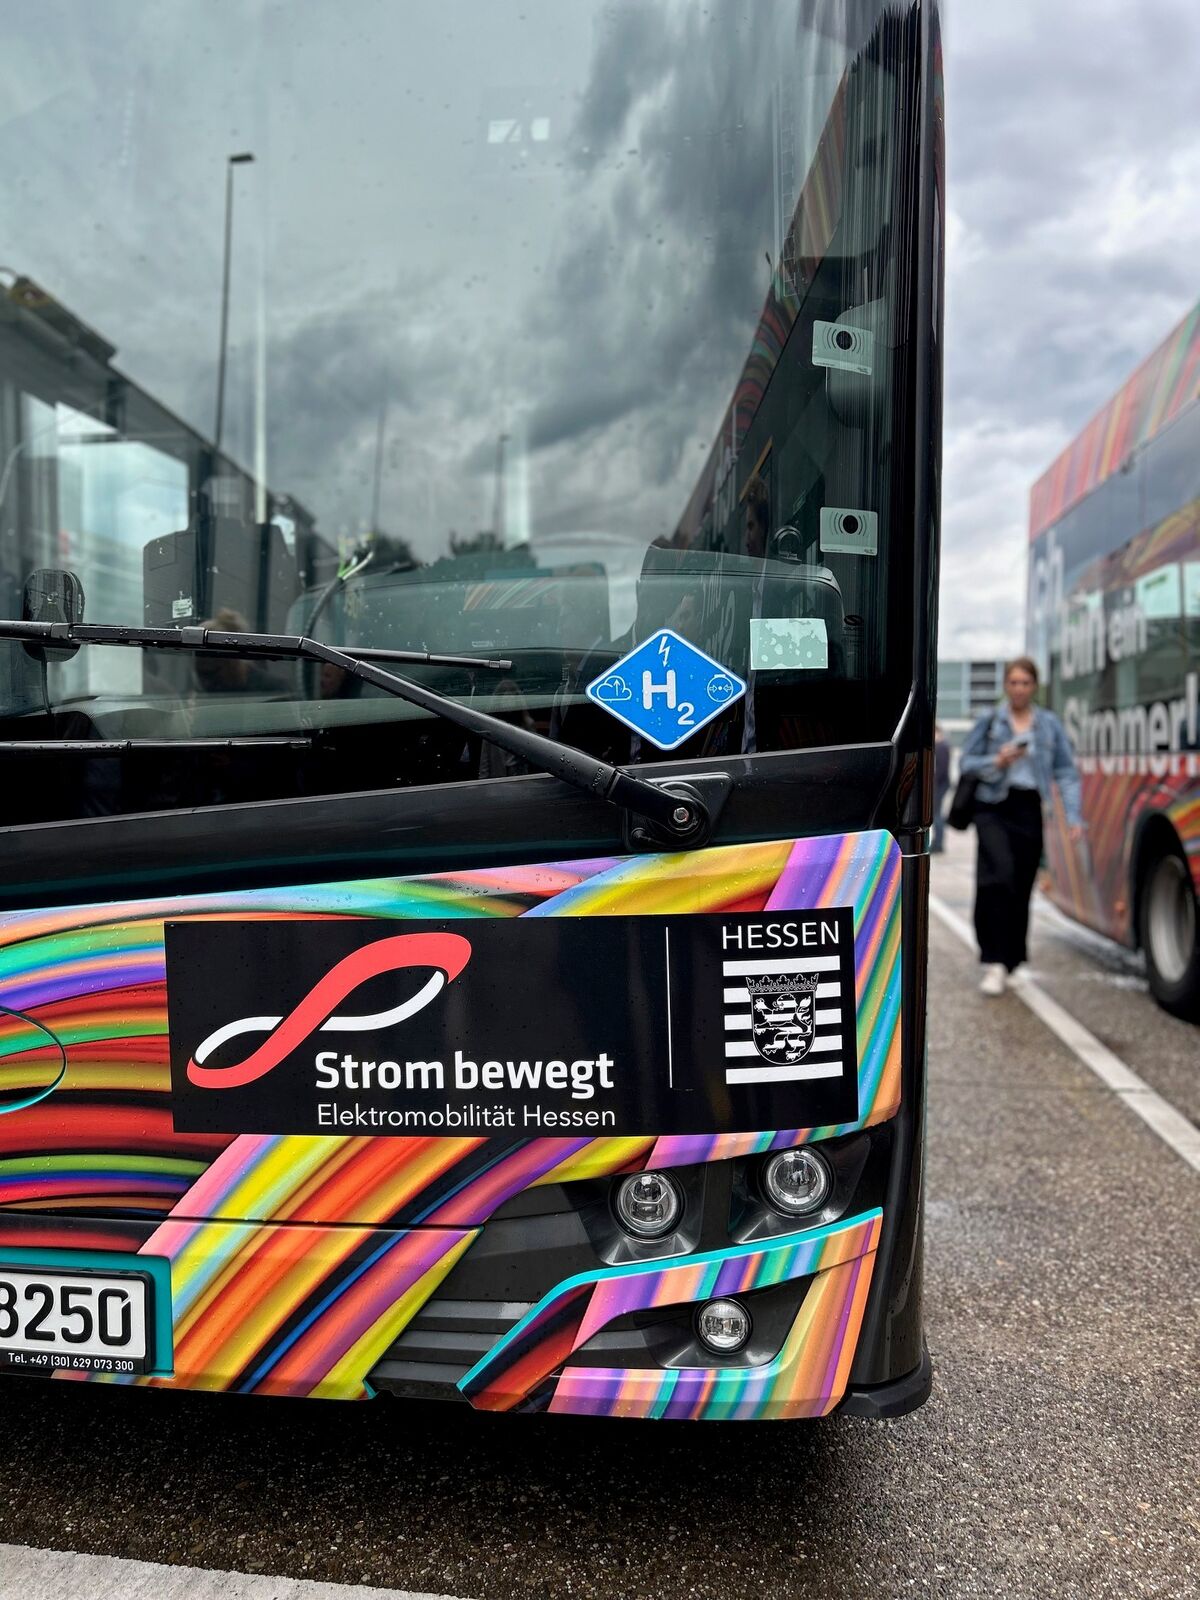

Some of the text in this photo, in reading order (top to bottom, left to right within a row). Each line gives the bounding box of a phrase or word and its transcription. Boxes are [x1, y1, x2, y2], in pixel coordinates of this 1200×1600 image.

[1058, 589, 1147, 680] bin ein
[1063, 670, 1199, 778] Stromer!
[722, 920, 840, 950] HESSEN
[315, 1050, 615, 1099] Strom bewegt
[317, 1103, 616, 1127] Elektromobilität Hessen
[8, 1352, 134, 1372] Tel. +49 (30) 629 073 300
